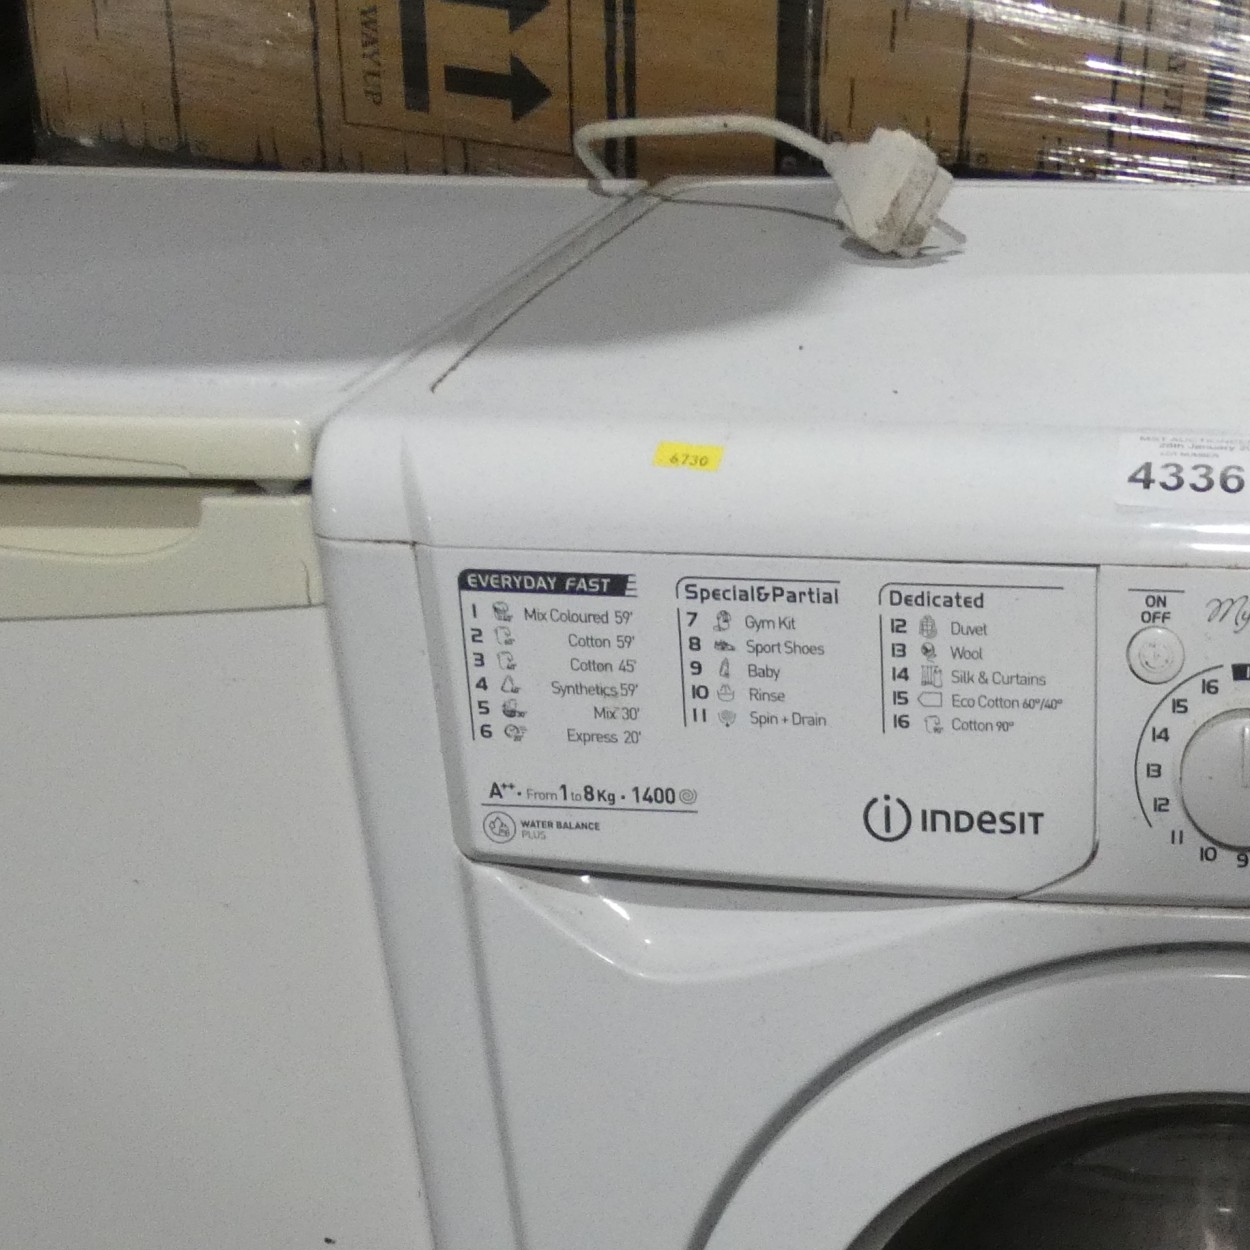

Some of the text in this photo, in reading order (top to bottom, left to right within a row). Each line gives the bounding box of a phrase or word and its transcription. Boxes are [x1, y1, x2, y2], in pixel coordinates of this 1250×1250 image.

[360, 5, 383, 107] WAY UP
[1128, 461, 1245, 494] 4336
[467, 575, 610, 593] EVERYDAY FAST
[889, 590, 984, 609] Dedicated
[1146, 596, 1167, 608] ON
[524, 607, 547, 622] Mix
[550, 609, 609, 624] Coloured
[686, 612, 796, 632] 7 Gym Kit
[1141, 612, 1171, 623] OFF
[890, 619, 987, 636] 12 Duvet
[471, 628, 483, 644] 2
[569, 633, 611, 649] Cotton
[689, 637, 824, 656] 8 Sport Shoes
[891, 643, 983, 660] 13 Wool
[473, 652, 485, 667] 3
[570, 658, 613, 673] Cotton
[690, 661, 780, 681] 9 Baby
[892, 667, 1046, 686] 14 Silk & Curtains
[475, 677, 488, 691] 4
[551, 681, 617, 700] Synthetics
[692, 685, 785, 702] 10 Rinse
[1202, 679, 1218, 694] 16
[892, 691, 908, 705] 15
[952, 695, 975, 709] Eco
[978, 696, 1019, 709] Cotton
[1172, 699, 1188, 713] 15
[478, 700, 490, 715] 5
[594, 707, 616, 721] Mix
[693, 708, 707, 722] 11
[750, 712, 778, 727] Spin
[792, 713, 826, 726] Drain
[893, 714, 910, 729] 16
[952, 718, 993, 733] Cotton
[480, 724, 493, 739] 6
[567, 729, 618, 746] Express
[1152, 728, 1170, 742] 14
[1147, 764, 1162, 778] 13
[489, 782, 675, 805] A++ From 1 to 8 Kg 1400
[1154, 798, 1170, 812] 12
[521, 820, 600, 831] WATER BALANCE
[522, 831, 546, 840] PLUS
[1171, 830, 1183, 844] 11
[1200, 847, 1217, 862] 10
[1237, 854, 1248, 868] 9
